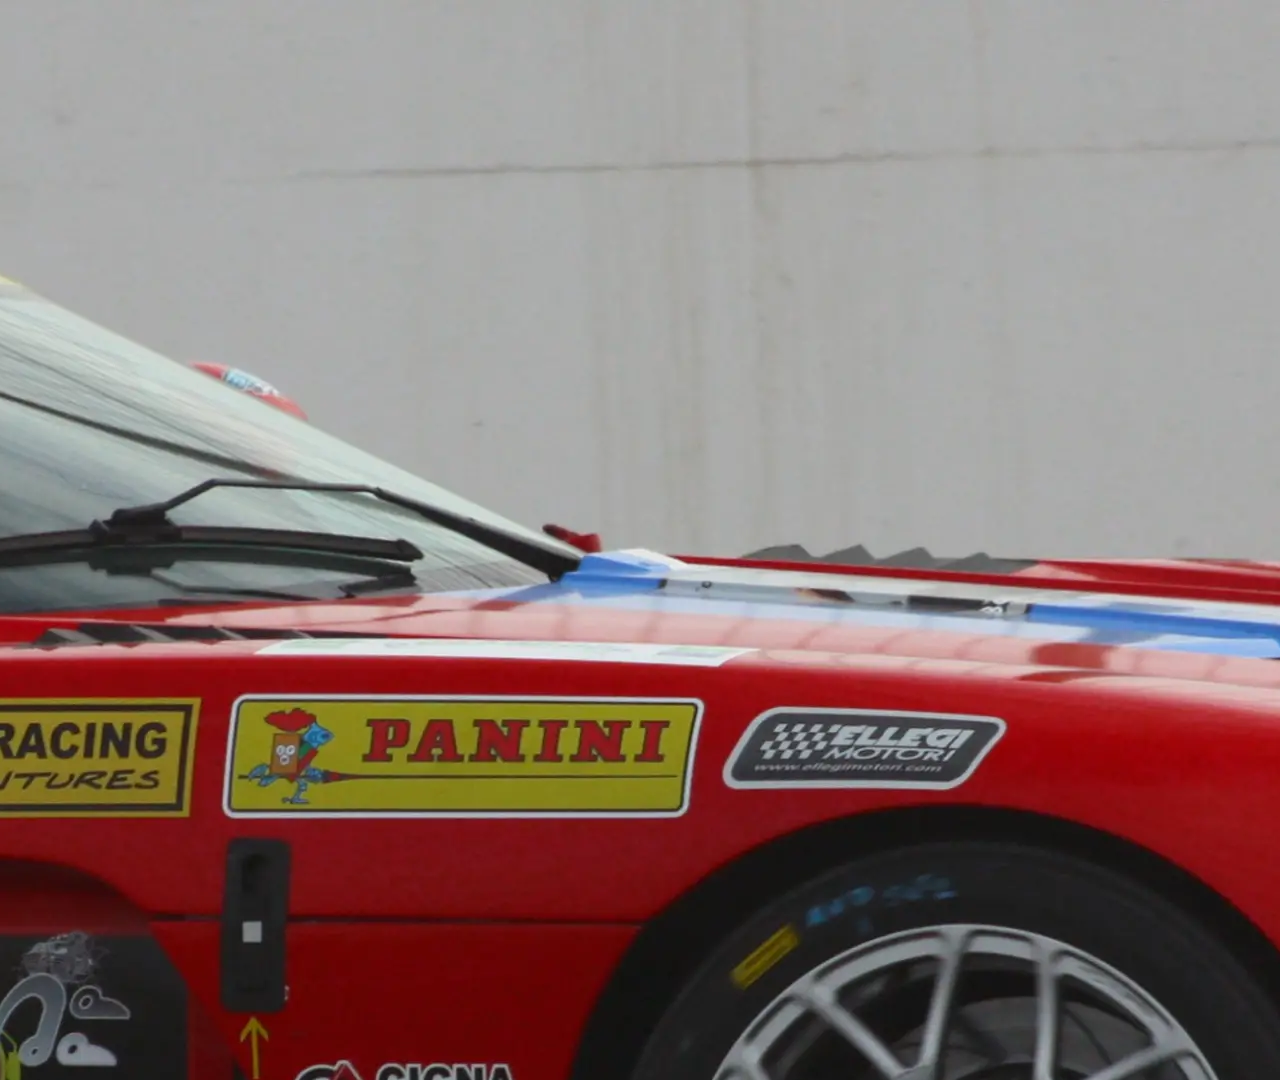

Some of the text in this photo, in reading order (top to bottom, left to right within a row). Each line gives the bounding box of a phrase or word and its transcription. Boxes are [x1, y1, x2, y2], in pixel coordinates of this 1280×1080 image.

[361, 719, 671, 764] PANINI
[830, 724, 975, 749] ELLEGI
[822, 747, 957, 762] MOTORI
